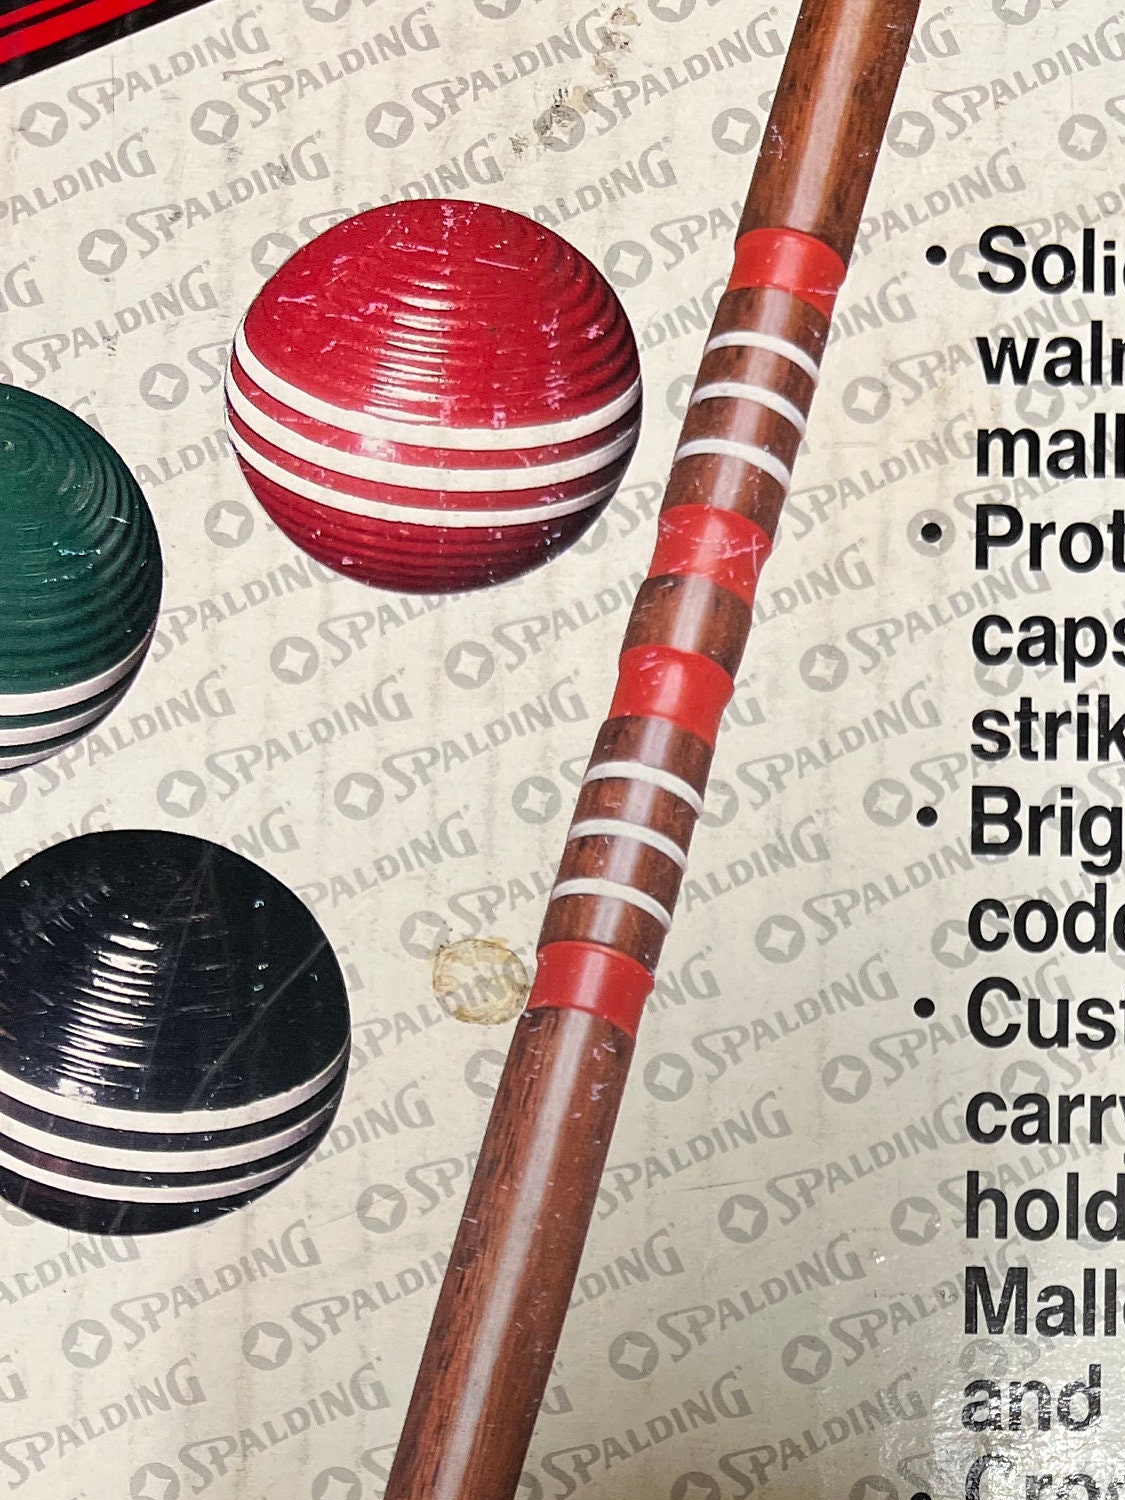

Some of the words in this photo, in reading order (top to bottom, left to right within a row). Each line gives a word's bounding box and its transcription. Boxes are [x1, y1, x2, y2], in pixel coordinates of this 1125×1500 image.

[67, 7, 268, 131] SPALDING
[238, 5, 438, 129] SPALDING
[413, 7, 612, 131] SPALDING
[583, 11, 782, 135] SPALDING
[126, 134, 327, 259] SPALDING
[13, 263, 215, 389] SPALDING
[780, 413, 980, 539] SPALDING
[205, 673, 409, 801] SPALDING
[382, 674, 585, 803] SPALDING
[737, 681, 939, 809] SPALDING
[803, 817, 1006, 946] SPALDING
[693, 953, 896, 1083] SPALDING
[766, 1095, 970, 1226] SPALDING
[111, 1218, 317, 1350] SPALDING
[657, 1231, 862, 1363] SPALDING
[0, 1357, 203, 1490] SPALDING
[179, 1361, 386, 1494] SPALDING
[961, 1363, 1101, 1434] and
